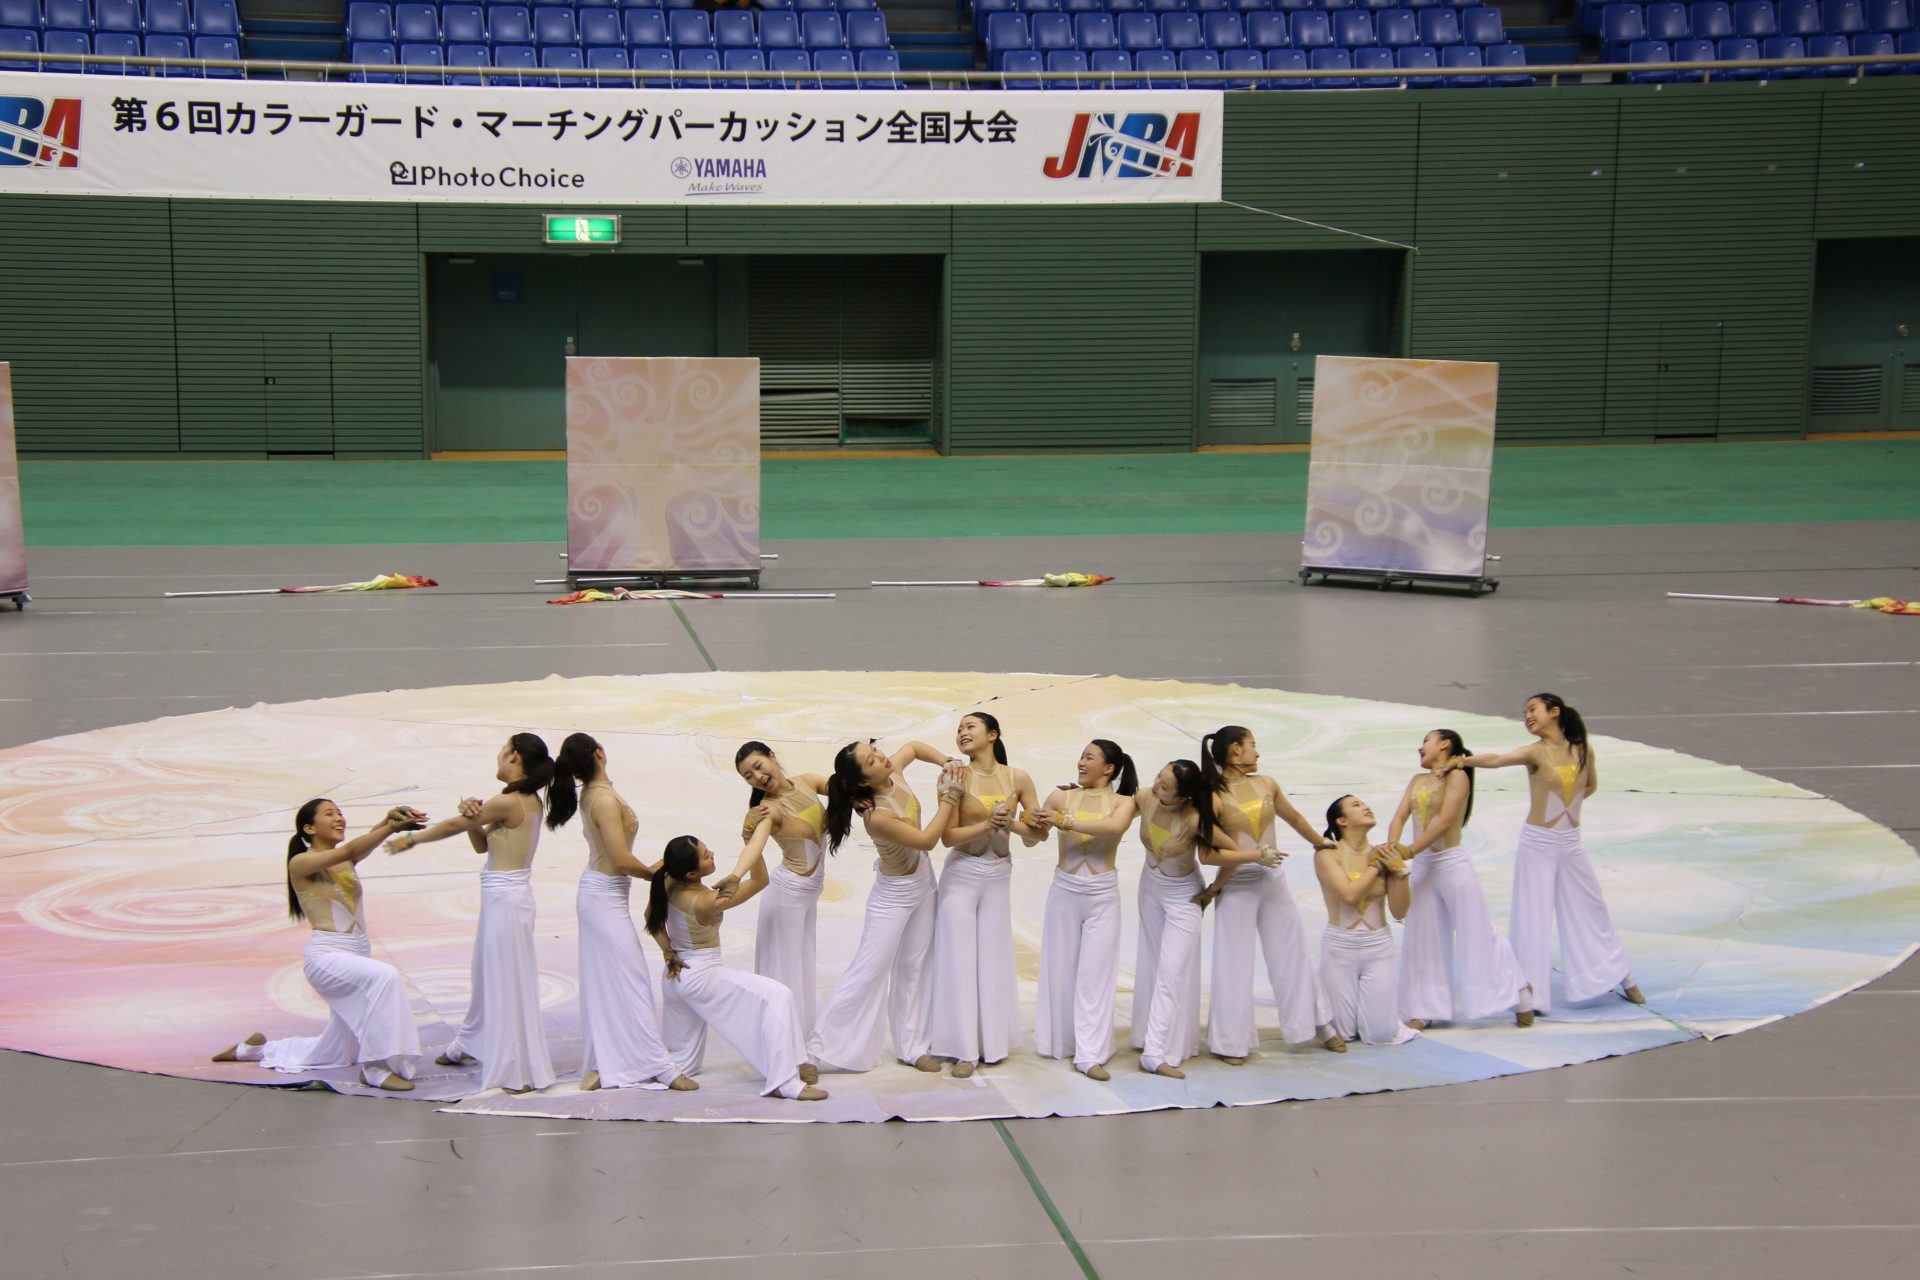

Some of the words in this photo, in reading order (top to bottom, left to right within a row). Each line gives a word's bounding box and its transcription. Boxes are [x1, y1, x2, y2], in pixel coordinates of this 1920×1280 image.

[111, 96, 1019, 145] 第6回カラーガード・マーチングパーカッション全国大会
[694, 158, 767, 178] YAMAHA
[687, 182, 722, 192] Make
[724, 182, 763, 192] Waves
